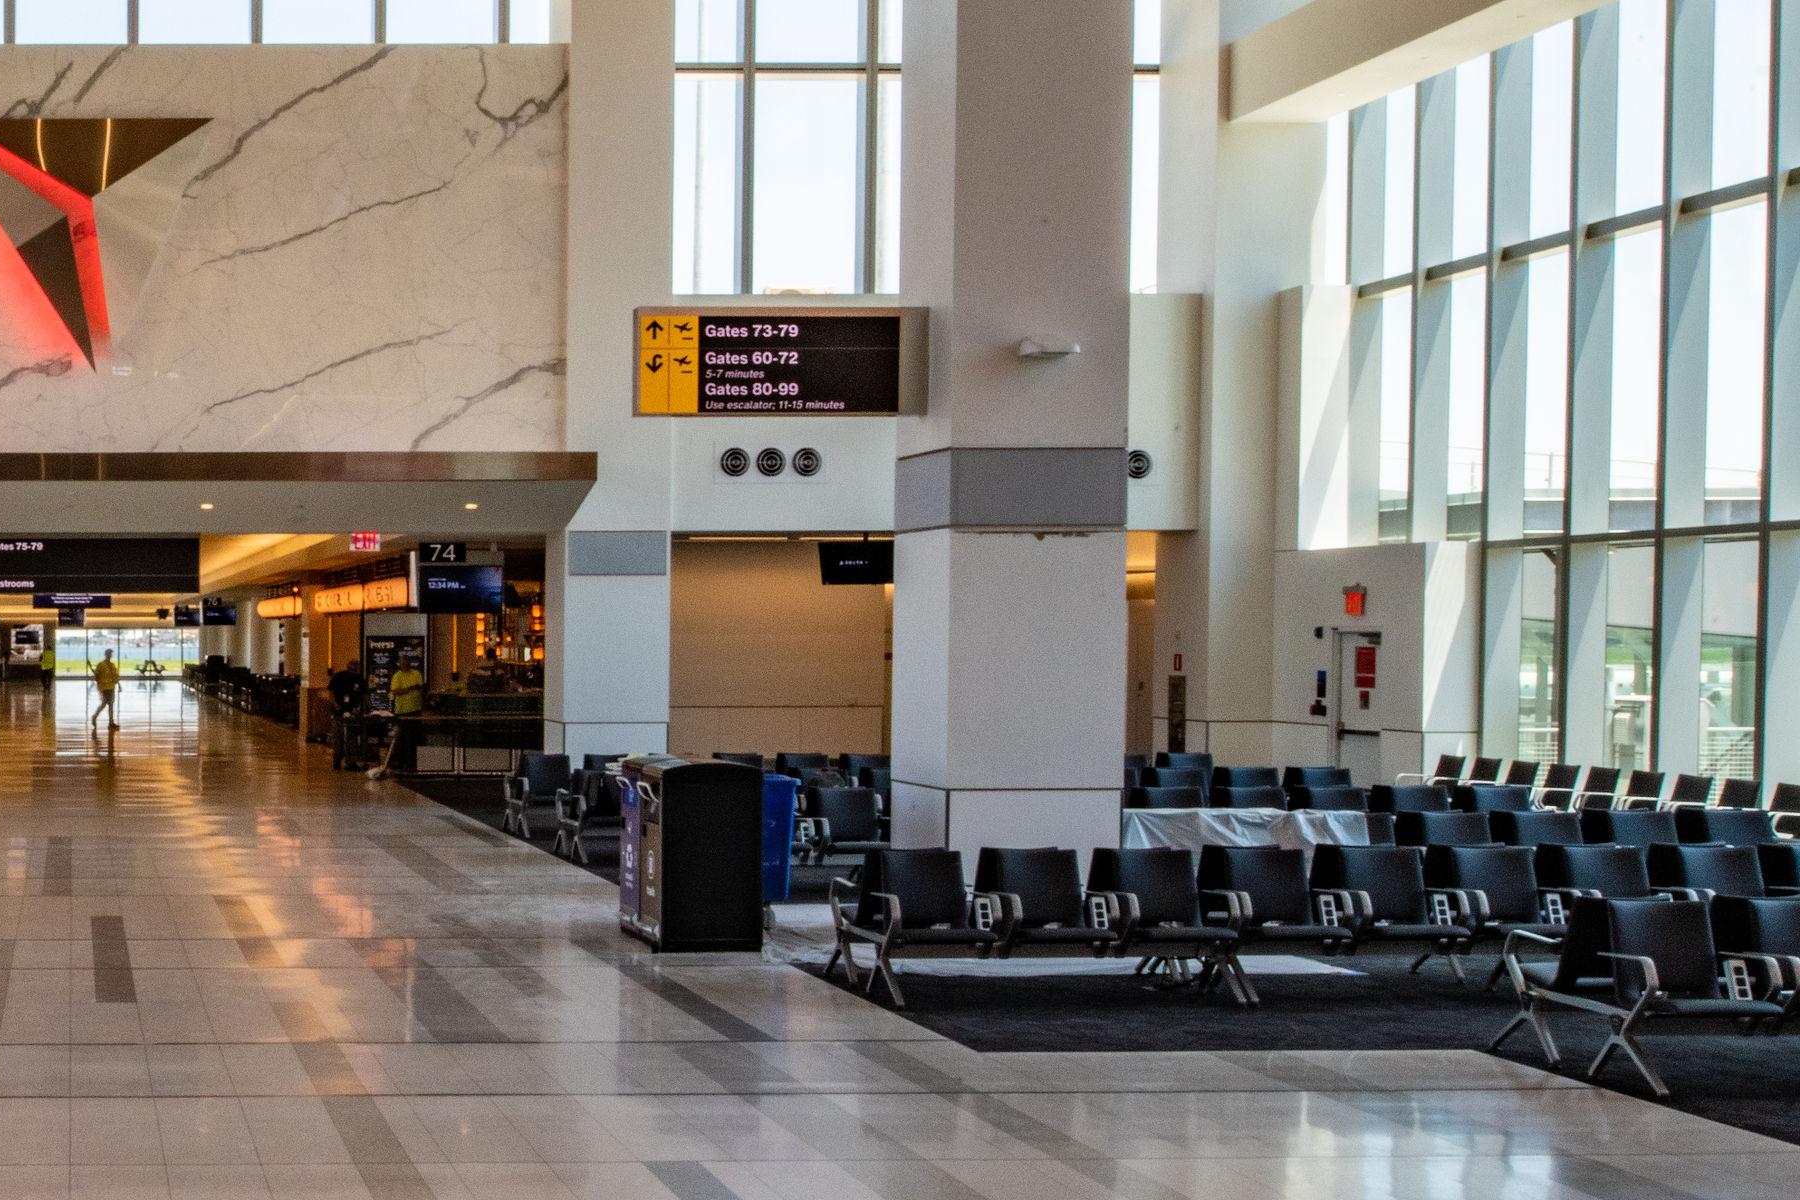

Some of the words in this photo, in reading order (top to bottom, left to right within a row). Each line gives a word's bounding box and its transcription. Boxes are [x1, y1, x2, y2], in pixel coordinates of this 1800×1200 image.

[705, 324, 749, 338] Gates
[752, 324, 799, 338] 73-79
[705, 351, 749, 365] Gates
[752, 351, 799, 365] 60-72
[705, 369, 723, 379] 5-7
[725, 369, 765, 379] minutes
[705, 382, 749, 396] Gates
[752, 382, 799, 396] 80-99
[705, 400, 724, 410] Use
[726, 400, 776, 411] escalator;
[779, 400, 803, 410] 11-15
[805, 400, 845, 410] minutes
[15, 542, 44, 551] 75-79
[352, 531, 377, 550] EXIT
[429, 544, 457, 562] 74
[427, 581, 446, 590] 12:34
[446, 581, 460, 590] PM
